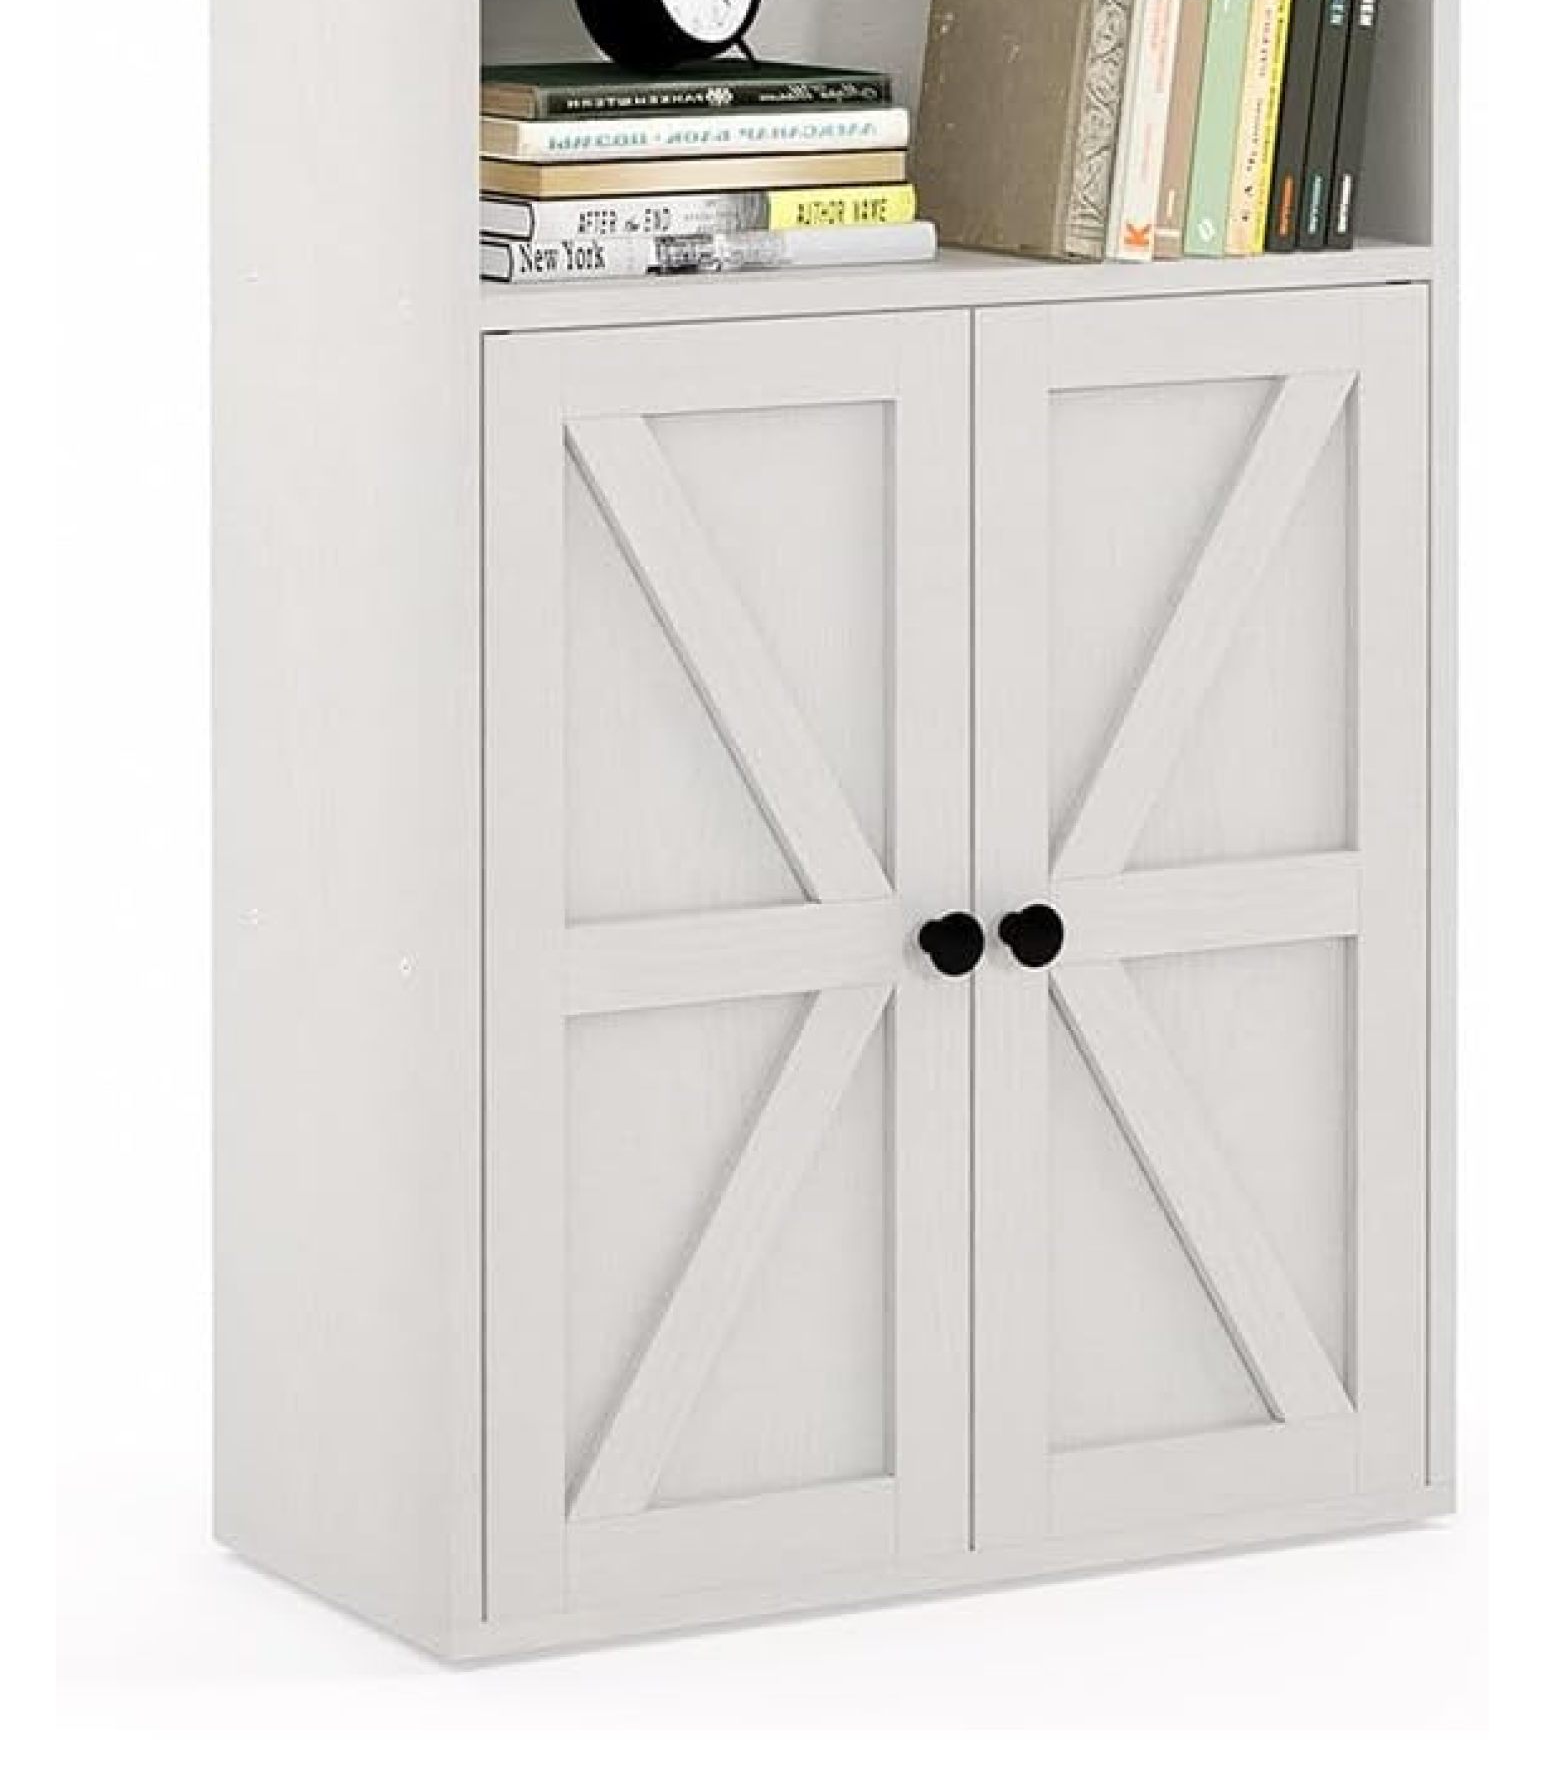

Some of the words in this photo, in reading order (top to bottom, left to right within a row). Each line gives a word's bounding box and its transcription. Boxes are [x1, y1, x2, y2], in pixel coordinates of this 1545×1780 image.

[578, 209, 617, 235] AFTER
[644, 205, 672, 233] END
[796, 199, 845, 226] AUTHOR
[852, 197, 888, 223] NAME
[518, 243, 560, 273] New
[561, 238, 606, 271] York
